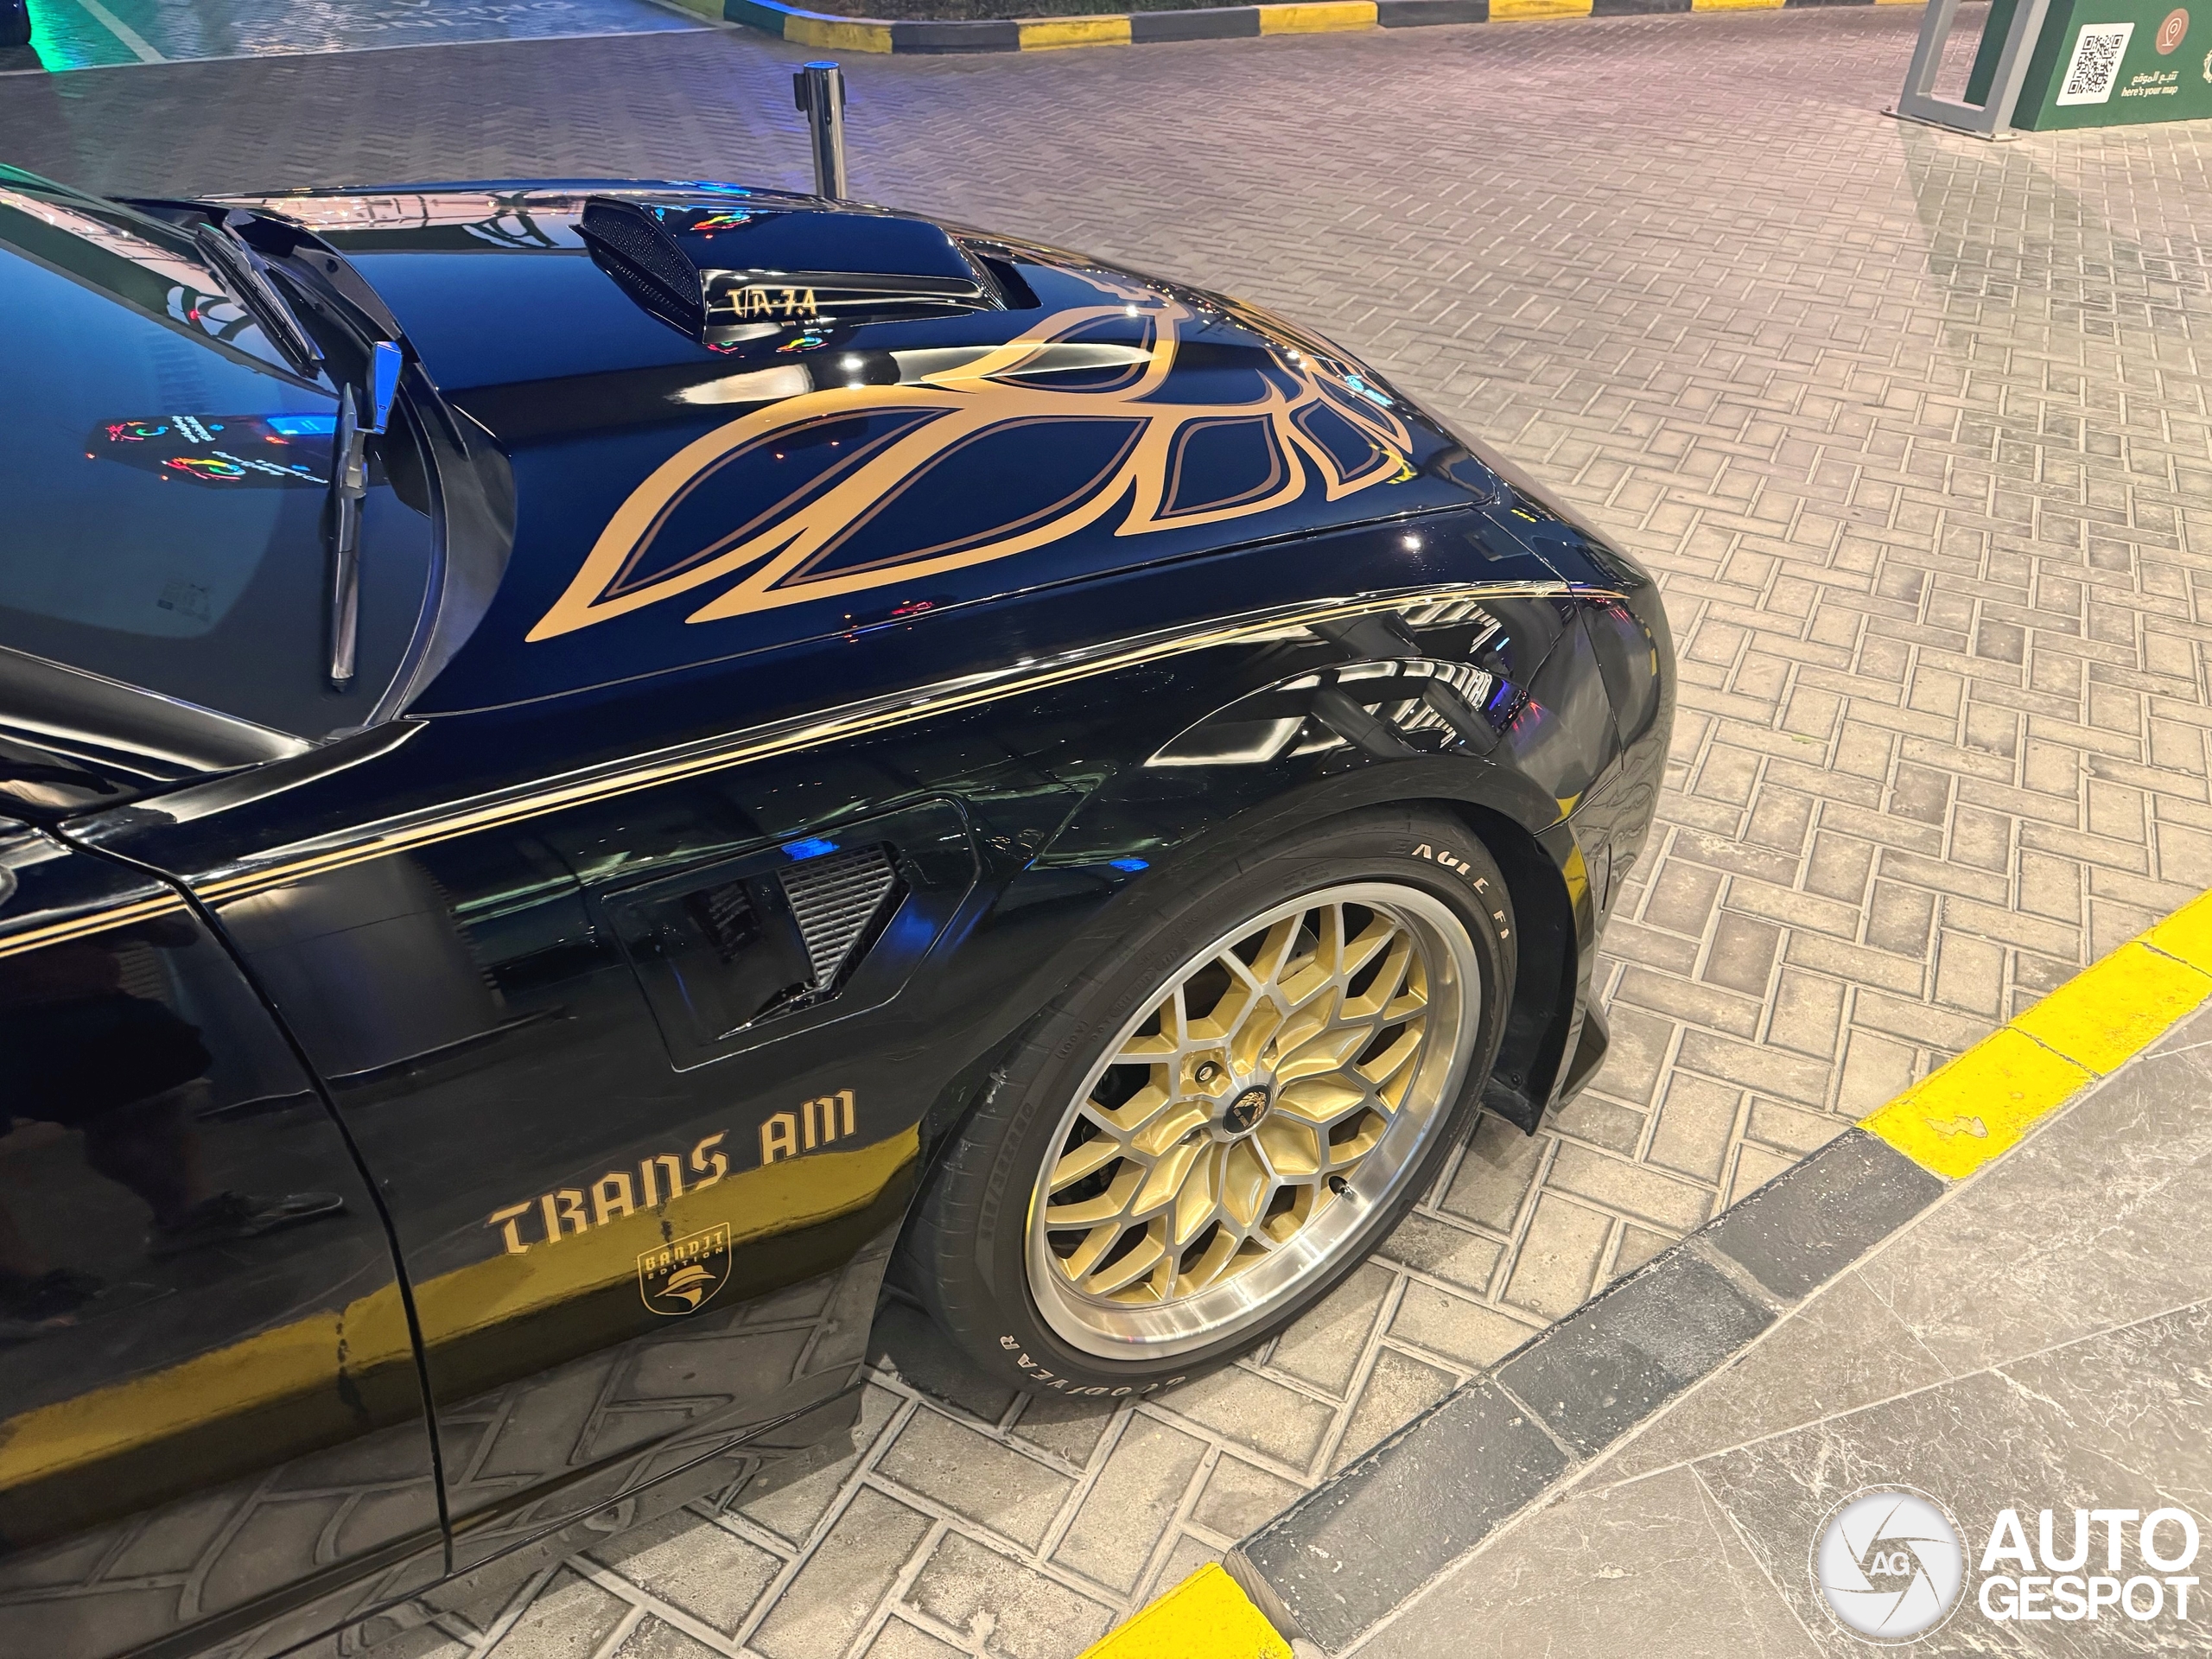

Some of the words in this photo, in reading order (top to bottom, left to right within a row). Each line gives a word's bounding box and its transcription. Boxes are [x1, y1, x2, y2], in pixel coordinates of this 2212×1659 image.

[338, 15, 510, 32] ONLY
[2131, 71, 2160, 86] الموقع
[2121, 86, 2144, 97] here's
[2143, 87, 2162, 98] your
[2162, 86, 2178, 96] map
[483, 1128, 729, 1256] TRANS
[759, 1087, 857, 1167] AM
[645, 1230, 723, 1272] BANDIT
[647, 1246, 723, 1281] EDITION
